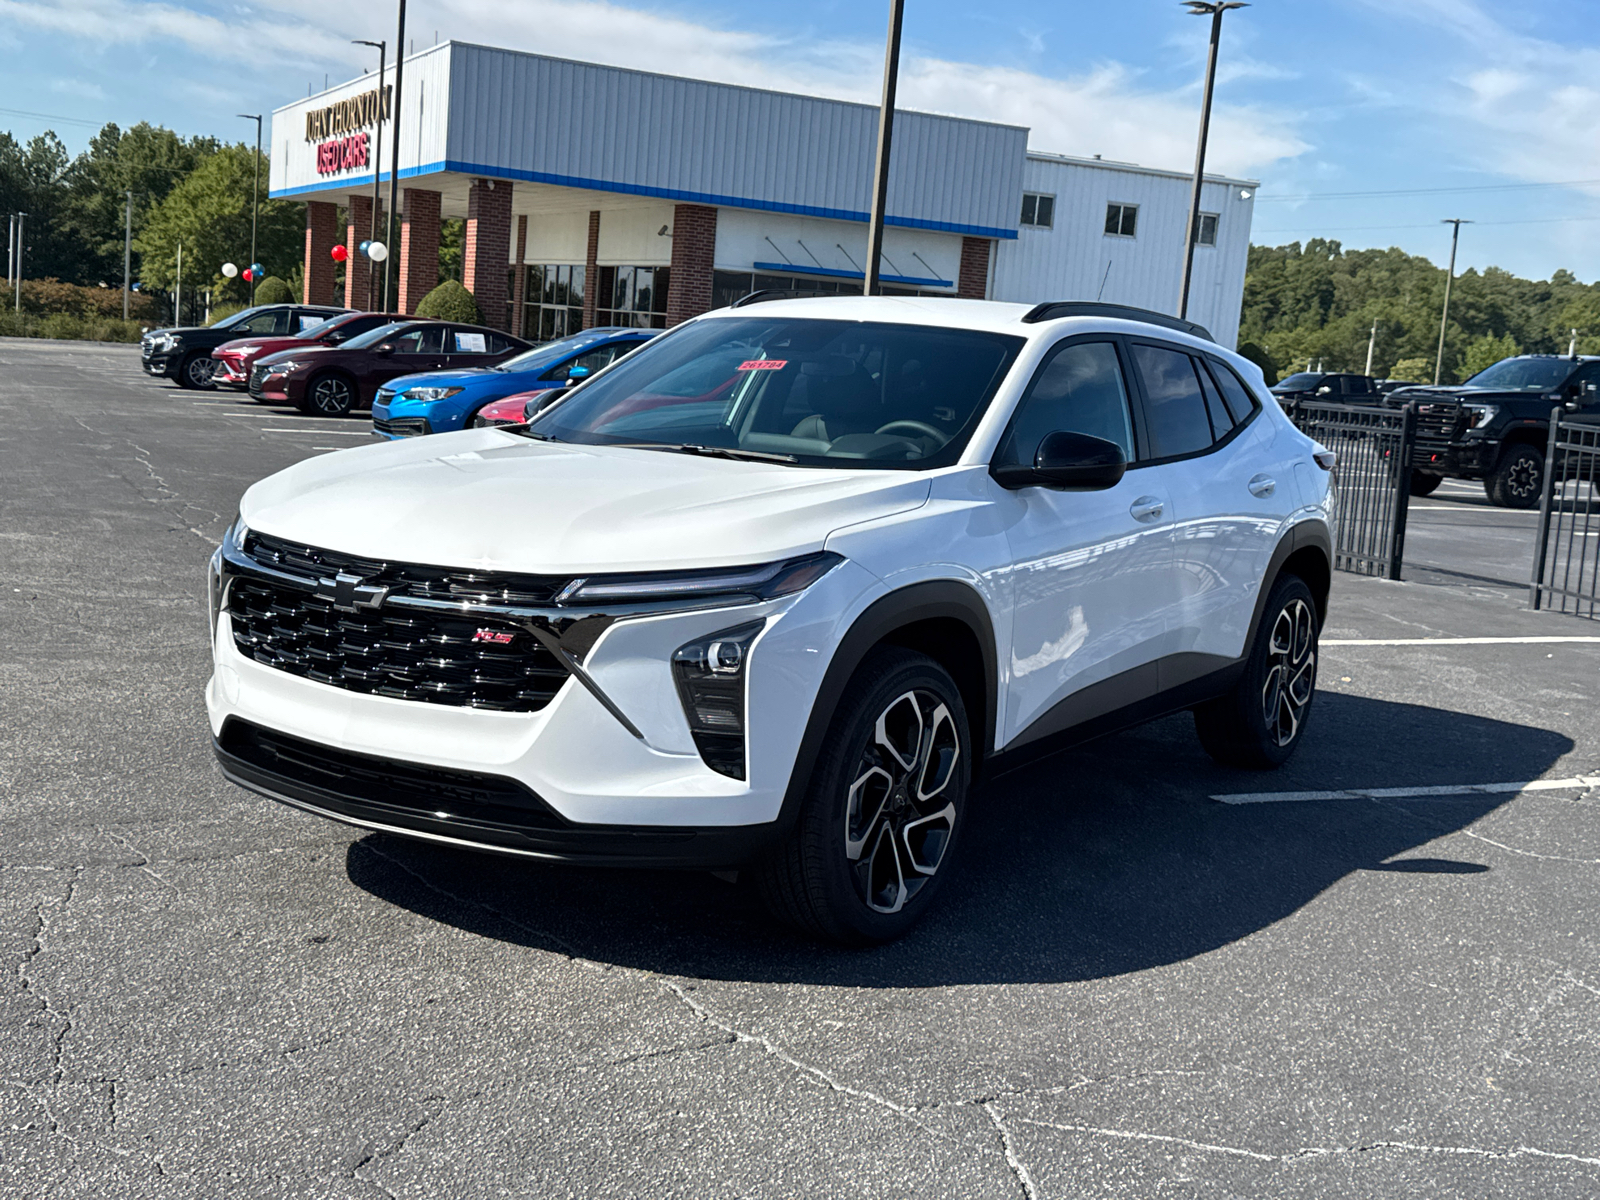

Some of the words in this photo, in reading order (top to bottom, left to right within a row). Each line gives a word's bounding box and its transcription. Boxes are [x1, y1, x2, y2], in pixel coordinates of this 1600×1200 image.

[305, 106, 330, 143] JOHN
[329, 85, 392, 134] THORNTON
[316, 140, 340, 174] USED
[340, 132, 369, 169] CARS
